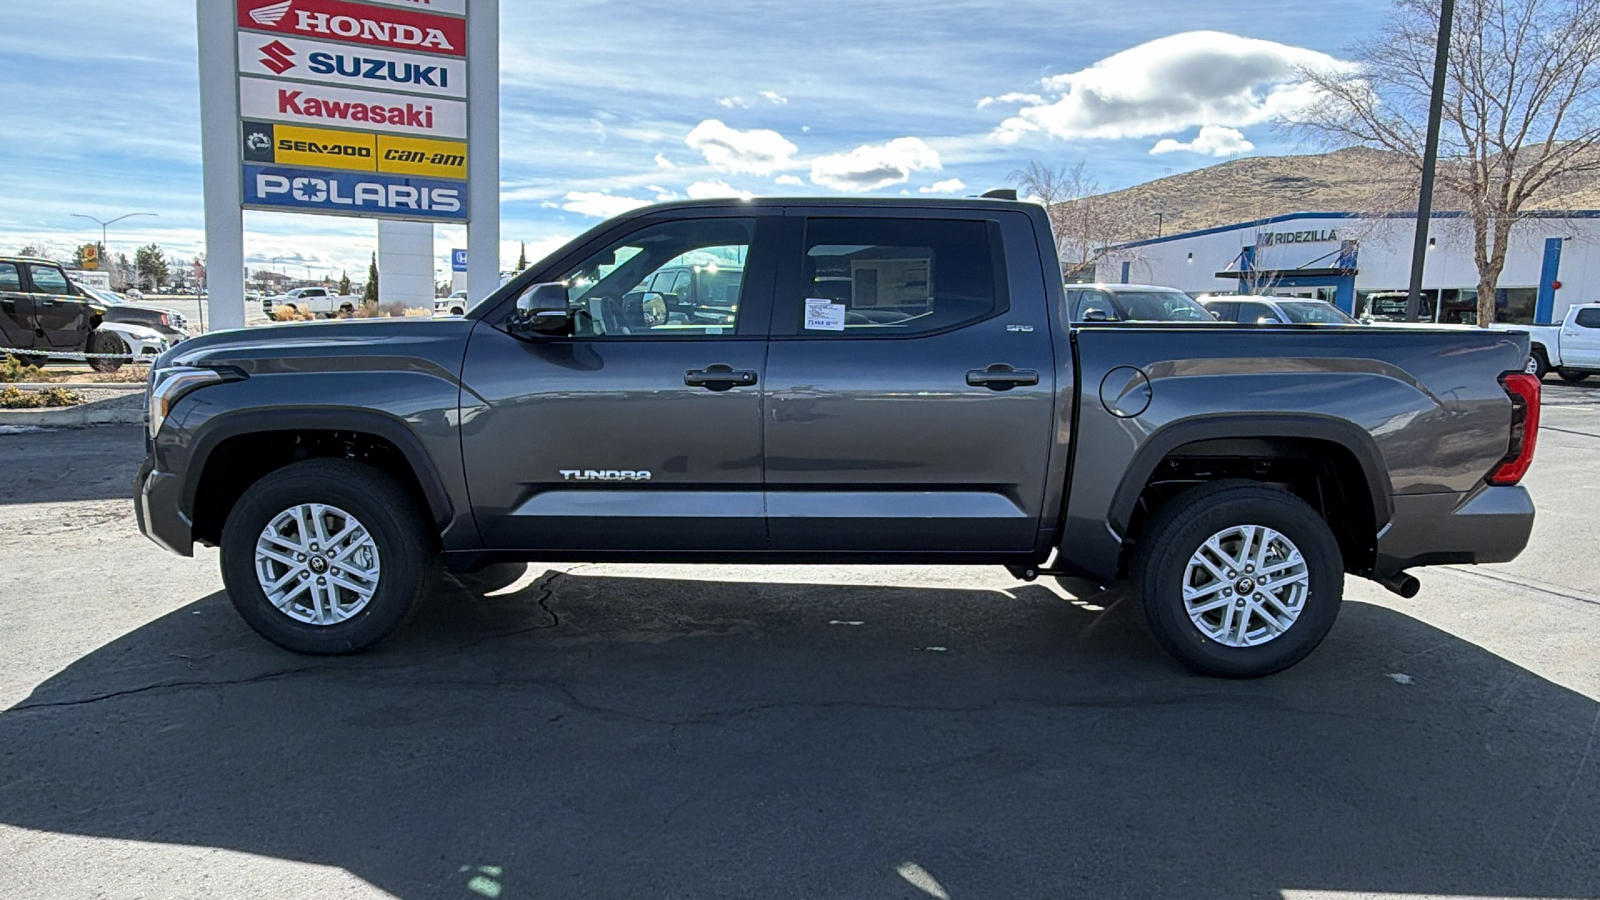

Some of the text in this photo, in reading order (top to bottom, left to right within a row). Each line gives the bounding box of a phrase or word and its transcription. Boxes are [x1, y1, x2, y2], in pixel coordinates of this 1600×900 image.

[294, 9, 454, 50] HONDA
[308, 52, 448, 87] SUZUKI
[278, 89, 433, 128] Kawasaki
[256, 174, 460, 212] POLARIS
[1275, 229, 1337, 244] RIDEZILLA
[559, 469, 652, 481] TUNDRA
